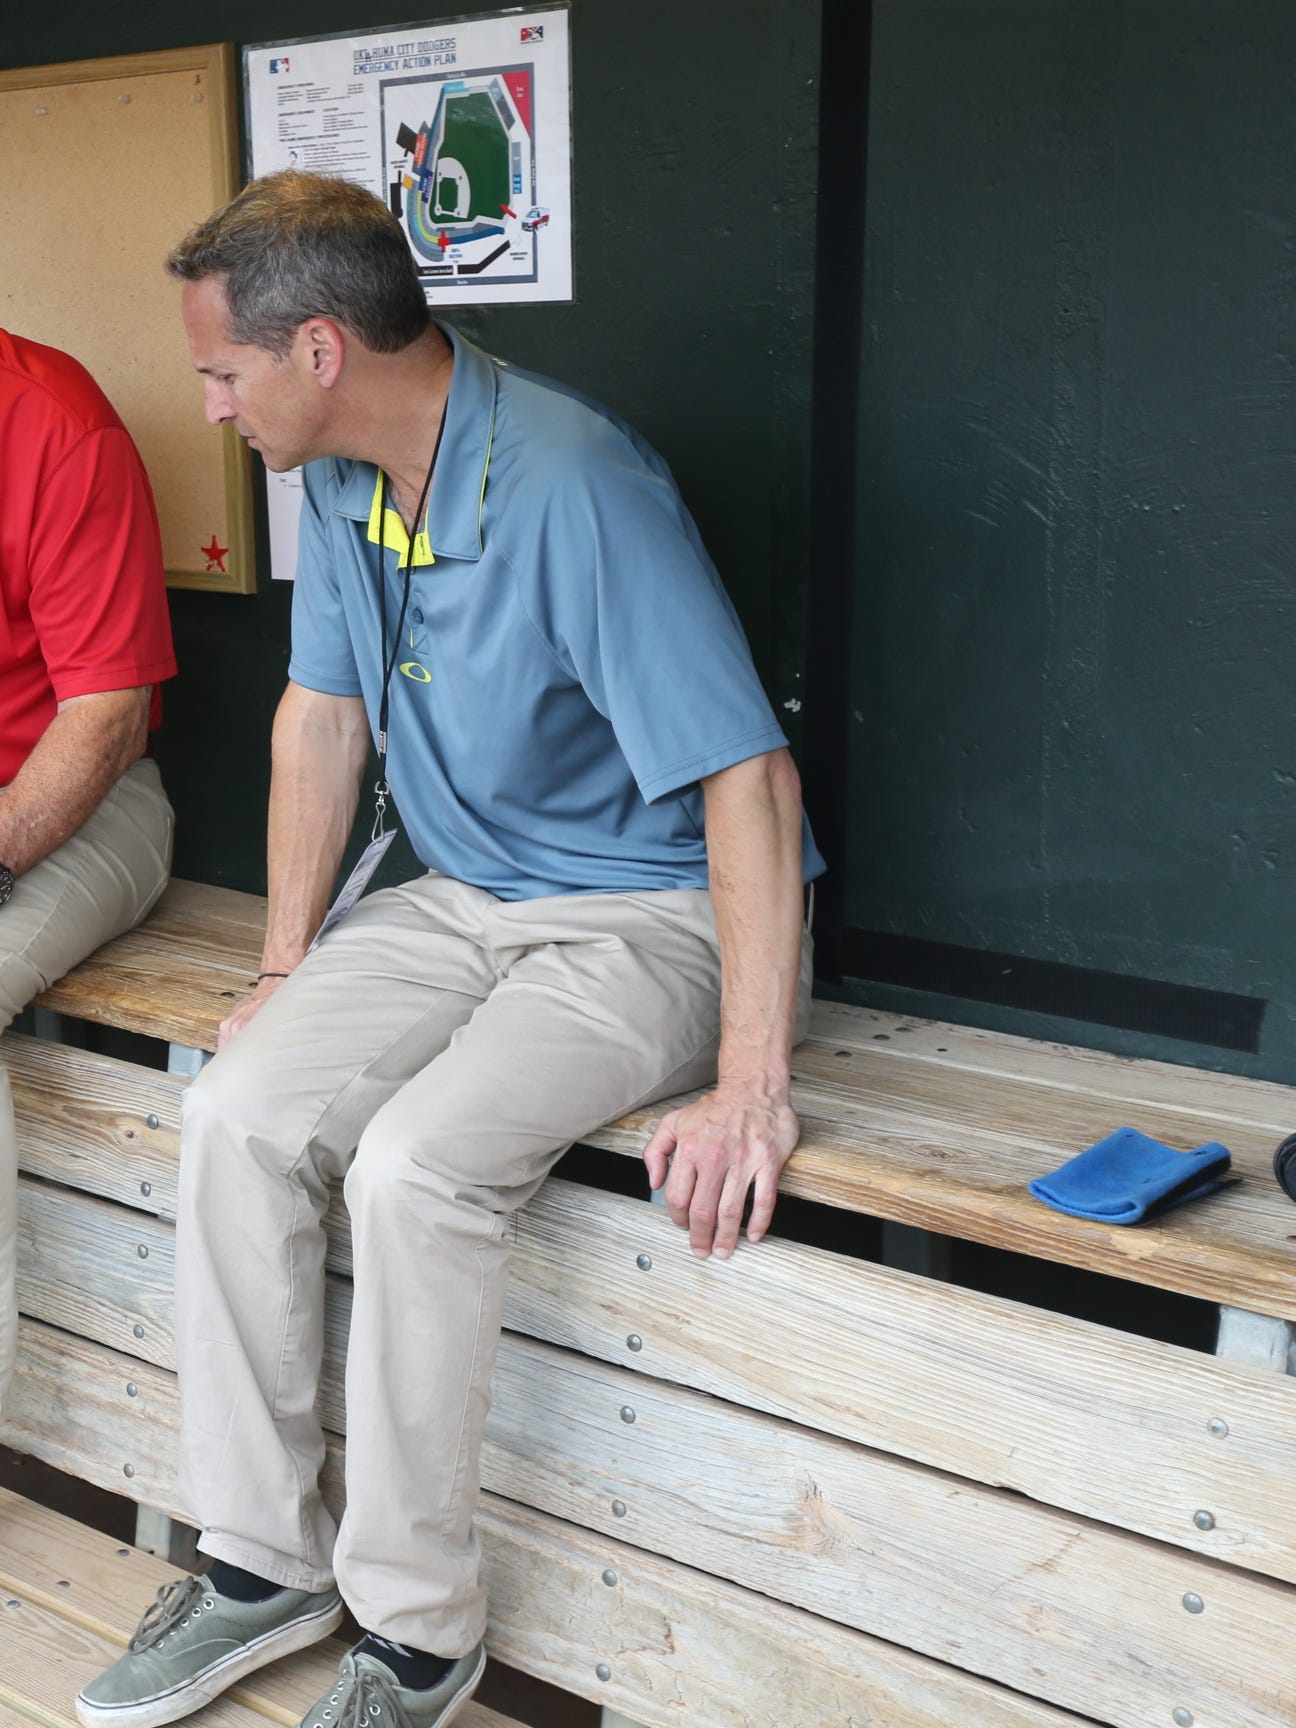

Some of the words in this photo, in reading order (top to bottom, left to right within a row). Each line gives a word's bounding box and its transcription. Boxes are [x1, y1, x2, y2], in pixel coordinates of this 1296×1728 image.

[397, 42, 415, 55] CITY
[417, 38, 456, 53] DODGERS
[354, 60, 399, 75] EMERGENCY
[403, 56, 431, 69] ACTION
[434, 53, 456, 65] PLAN
